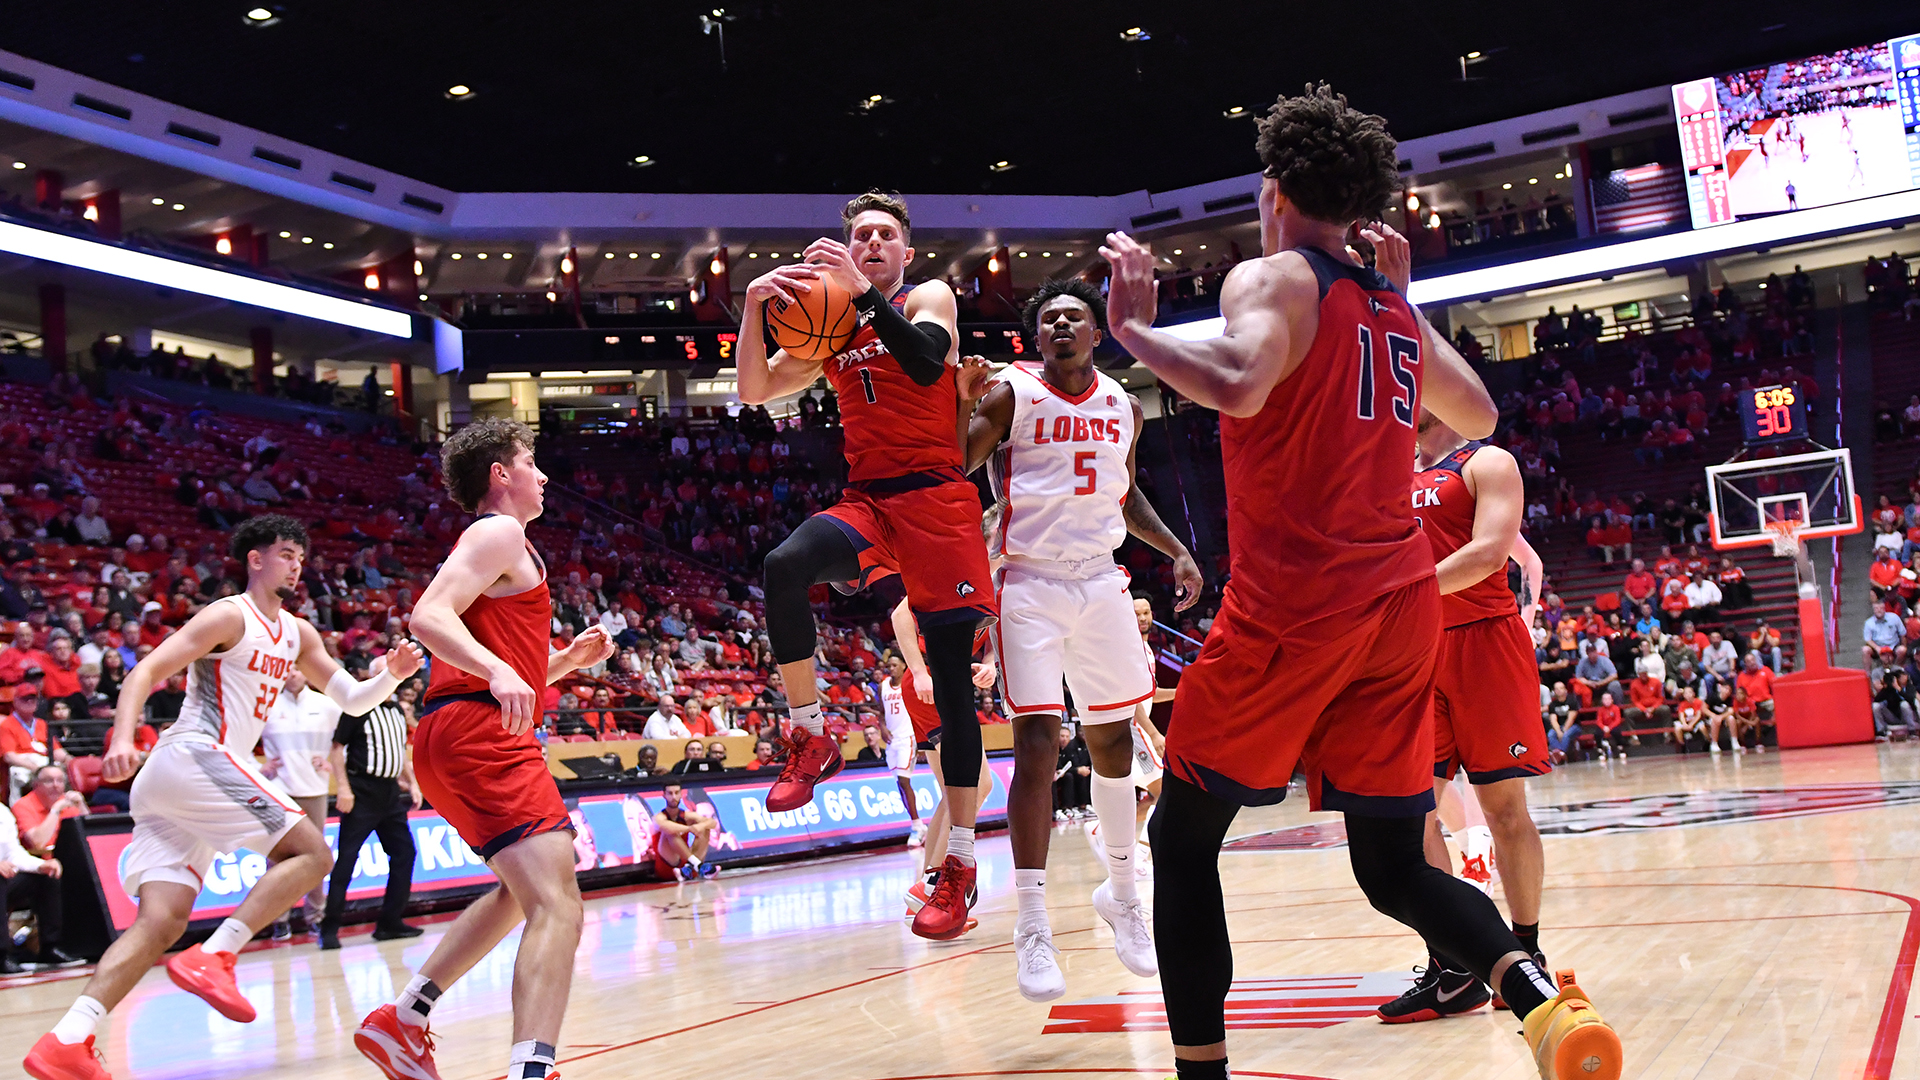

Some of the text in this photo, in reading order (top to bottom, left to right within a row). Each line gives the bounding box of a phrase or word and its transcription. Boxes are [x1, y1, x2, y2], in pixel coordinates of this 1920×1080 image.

[685, 341, 698, 359] 5
[1012, 336, 1024, 354] 5
[858, 367, 877, 404] 1
[1357, 323, 1420, 428] 15
[1755, 387, 1795, 409] 6:05
[1034, 415, 1120, 445] LOBOS
[1755, 405, 1792, 436] 30
[1074, 451, 1097, 495] 5
[253, 683, 279, 722] 22
[884, 693, 902, 701] LOBO
[890, 702, 900, 715] 15
[741, 797, 821, 832] Route
[823, 789, 857, 820] 66
[859, 785, 934, 817] Casno
